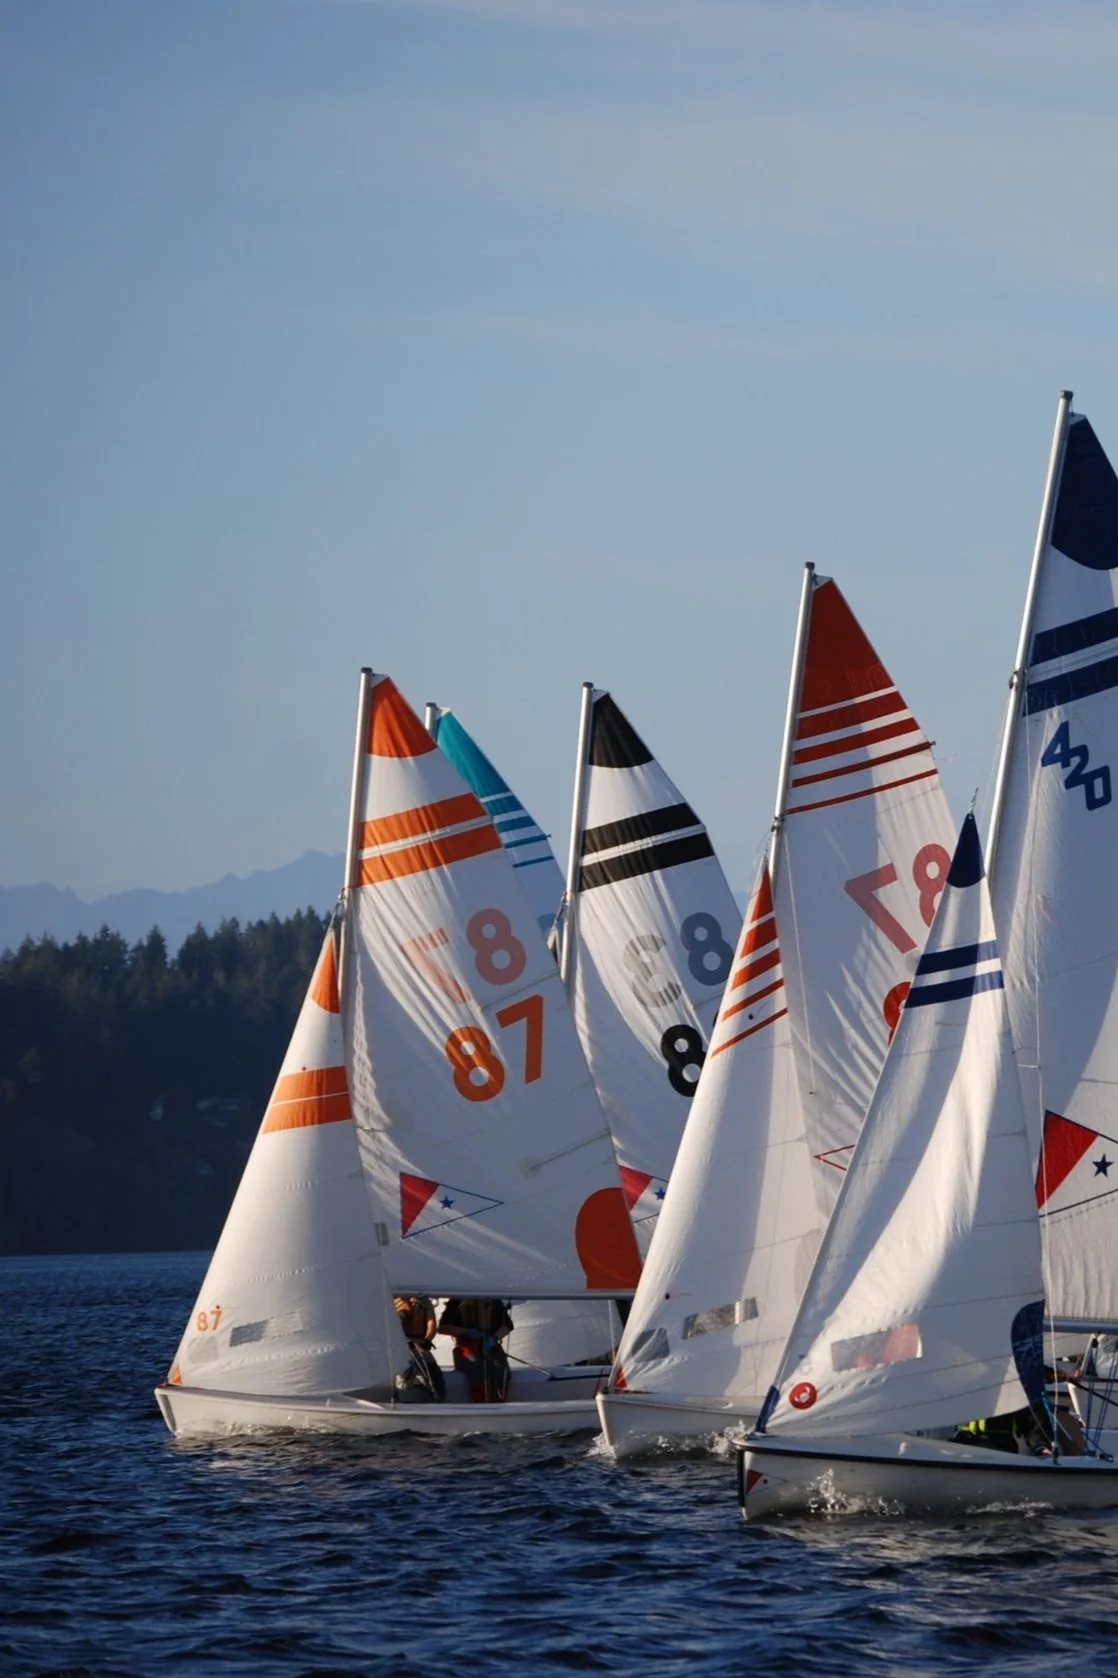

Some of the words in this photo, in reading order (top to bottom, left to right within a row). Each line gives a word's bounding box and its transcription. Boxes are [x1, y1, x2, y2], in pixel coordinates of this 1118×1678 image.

[1040, 721, 1112, 811] 420
[445, 994, 544, 1102] 87
[197, 1310, 222, 1331] 87
